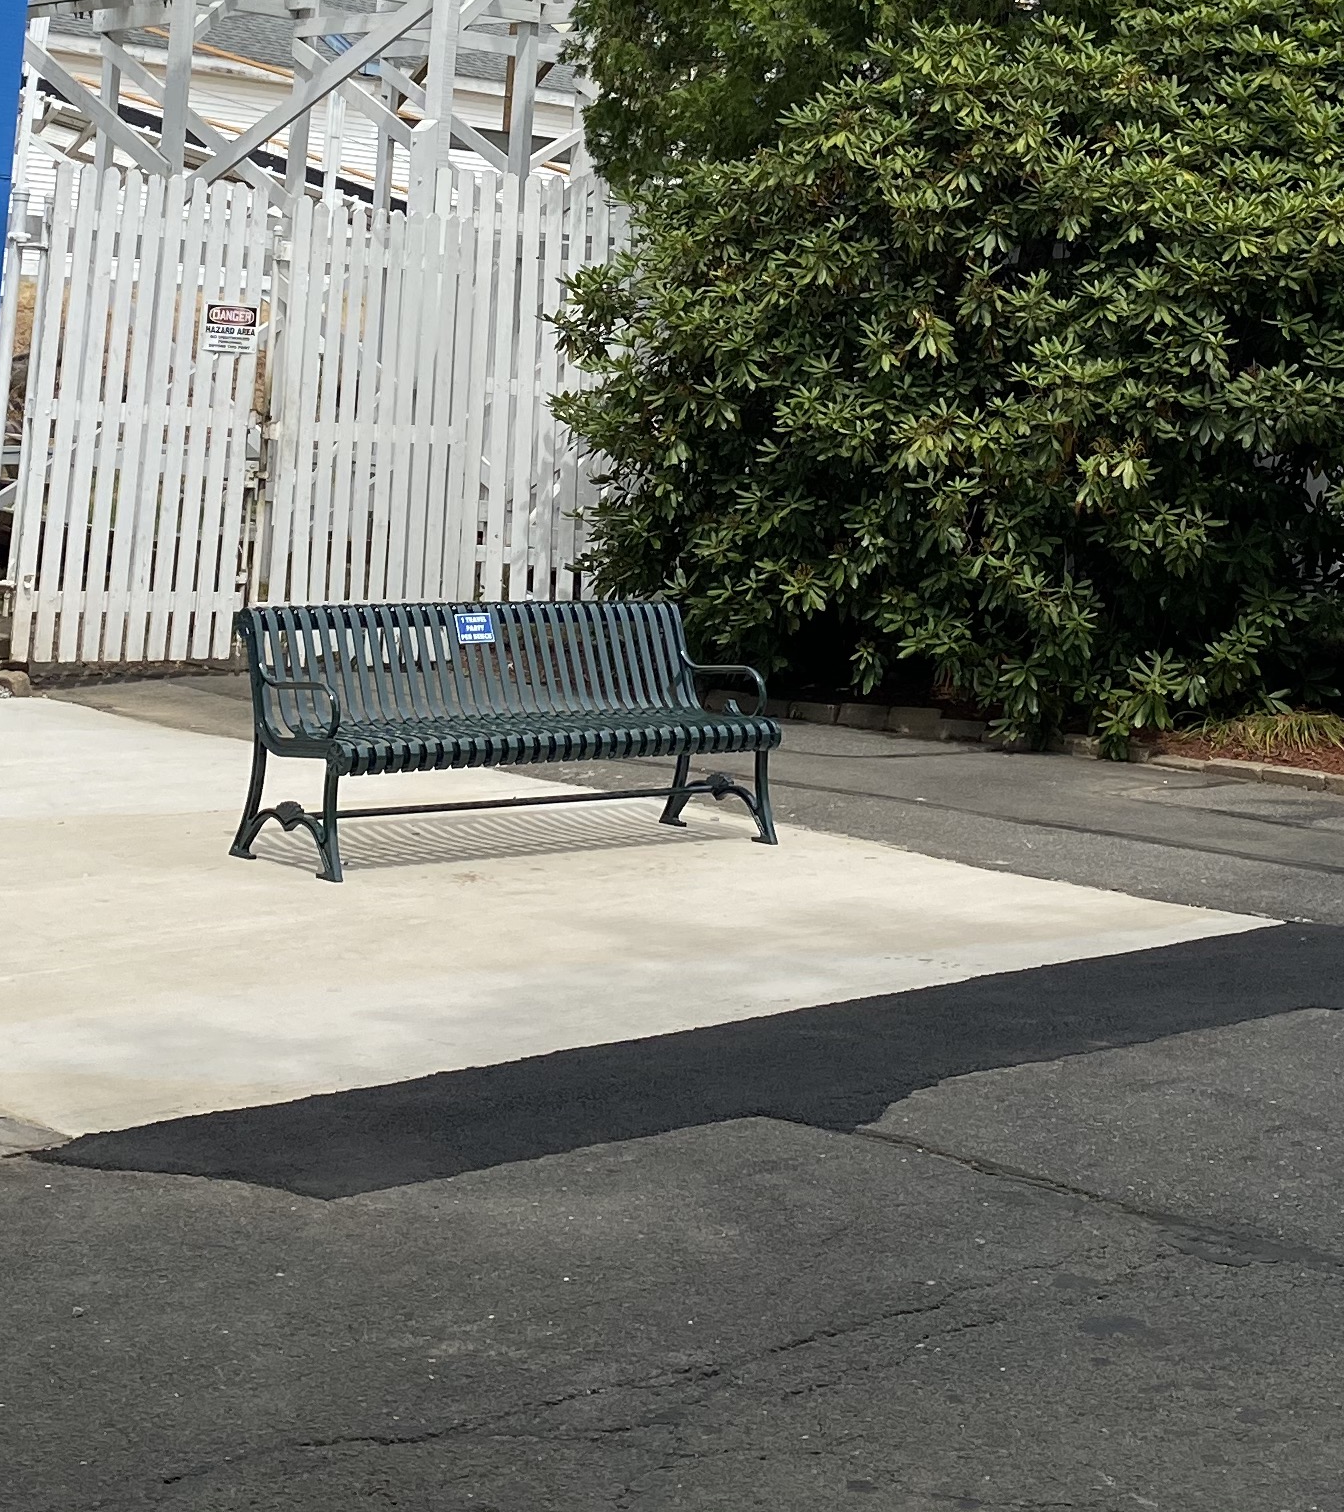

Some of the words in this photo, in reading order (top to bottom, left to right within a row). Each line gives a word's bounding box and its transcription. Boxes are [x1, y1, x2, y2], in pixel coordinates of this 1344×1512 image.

[212, 309, 252, 322] DANGER
[205, 325, 235, 335] HAZARD
[236, 327, 256, 336] AREA
